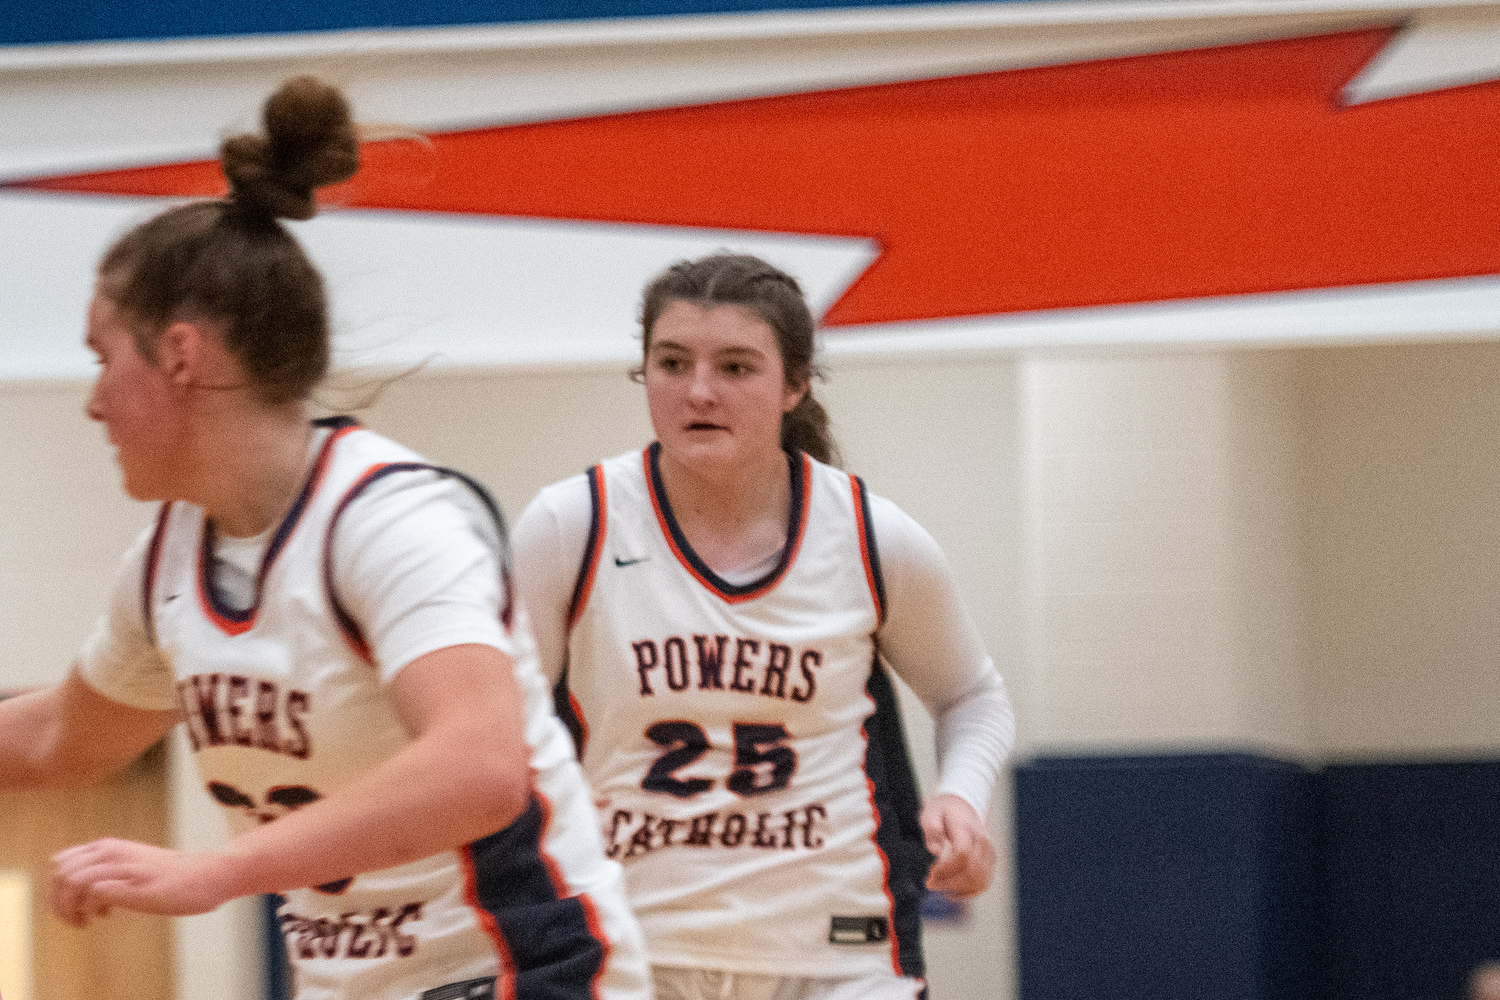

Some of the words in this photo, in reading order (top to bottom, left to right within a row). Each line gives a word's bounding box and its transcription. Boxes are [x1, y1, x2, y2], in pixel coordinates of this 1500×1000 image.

[631, 633, 825, 704] POWERS
[641, 719, 799, 800] 25
[604, 803, 828, 859] CATHOLIC
